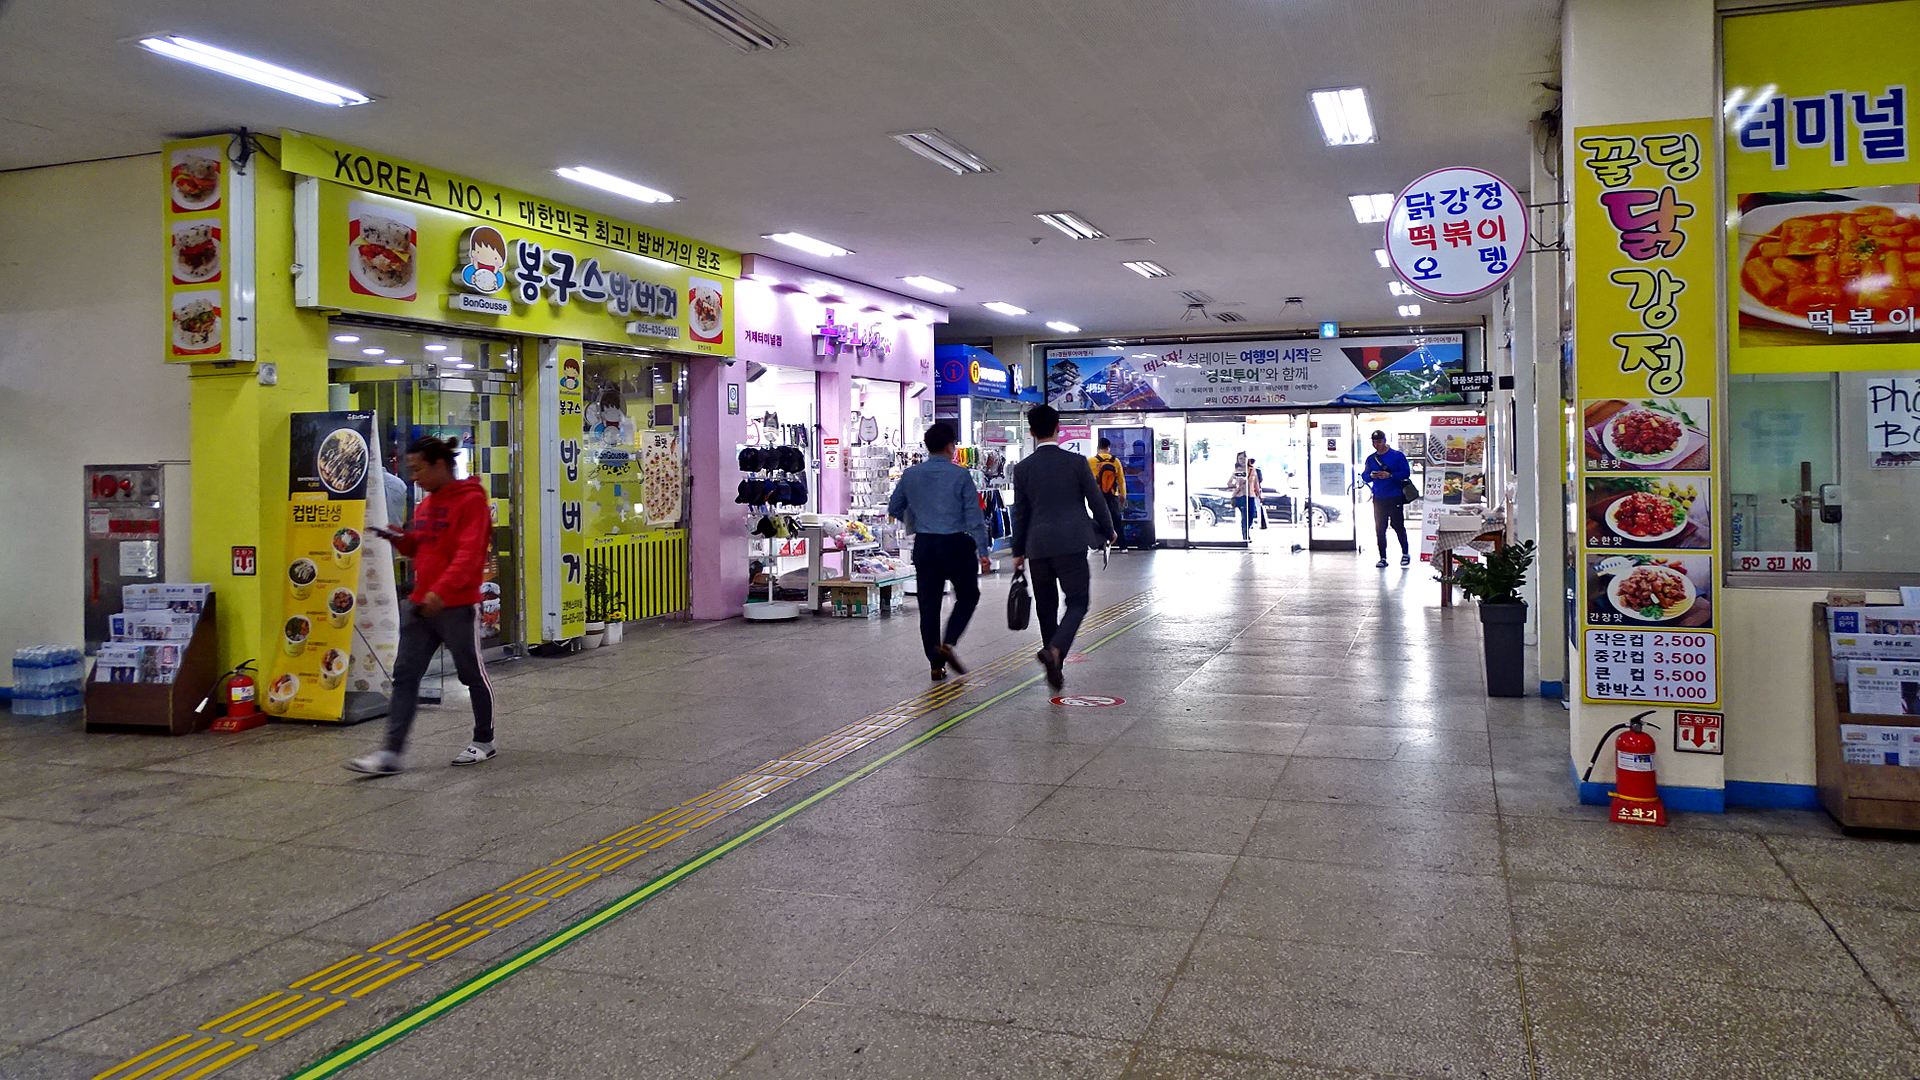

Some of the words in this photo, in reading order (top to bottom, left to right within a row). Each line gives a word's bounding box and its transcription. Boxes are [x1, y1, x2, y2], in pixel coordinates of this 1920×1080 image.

[1404, 182, 1503, 221] 닭강정
[334, 150, 432, 200] KOREA
[448, 179, 502, 217] NO.1
[519, 200, 590, 239] 대한민국
[595, 220, 632, 250] 최고!
[637, 231, 692, 265] 밥버거의
[696, 246, 720, 271] 원조
[1407, 215, 1507, 251] 떡볶이
[1413, 246, 1508, 280] 오뎅
[516, 240, 678, 318] 봉구스밥버거
[1600, 186, 1695, 395] 닭강정
[463, 296, 508, 312] BonGousse
[1807, 306, 1916, 335] 떡볶이
[638, 322, 677, 337] 055-635-5032
[744, 330, 783, 347] 거제터미널점
[1143, 349, 1183, 373] 떠나자!
[1187, 351, 1238, 366] 설레이는
[1240, 348, 1279, 365] 여행의
[1282, 347, 1323, 364] 시작은
[1282, 366, 1309, 381] 함께
[1452, 375, 1490, 385] 물품보관함
[560, 400, 581, 415] 봉구스
[1450, 416, 1480, 425] 김밥나라
[1588, 459, 1622, 469] 매운맛
[293, 504, 342, 523] 컵밥탄생
[560, 440, 582, 585] 밥버거
[1589, 536, 1623, 546] 순한맛
[1589, 612, 1623, 623] 간장맛
[1594, 633, 1644, 647] 작은컵
[1653, 635, 1706, 648] 2,500
[1594, 650, 1645, 664] 중간컵
[1653, 652, 1706, 665] 3,500
[1654, 669, 1707, 683] 5,500
[1596, 683, 1647, 697] 한박스
[1654, 686, 1707, 699] 11,000
[1681, 715, 1719, 726] 소화기
[1618, 807, 1657, 820] 소화기
